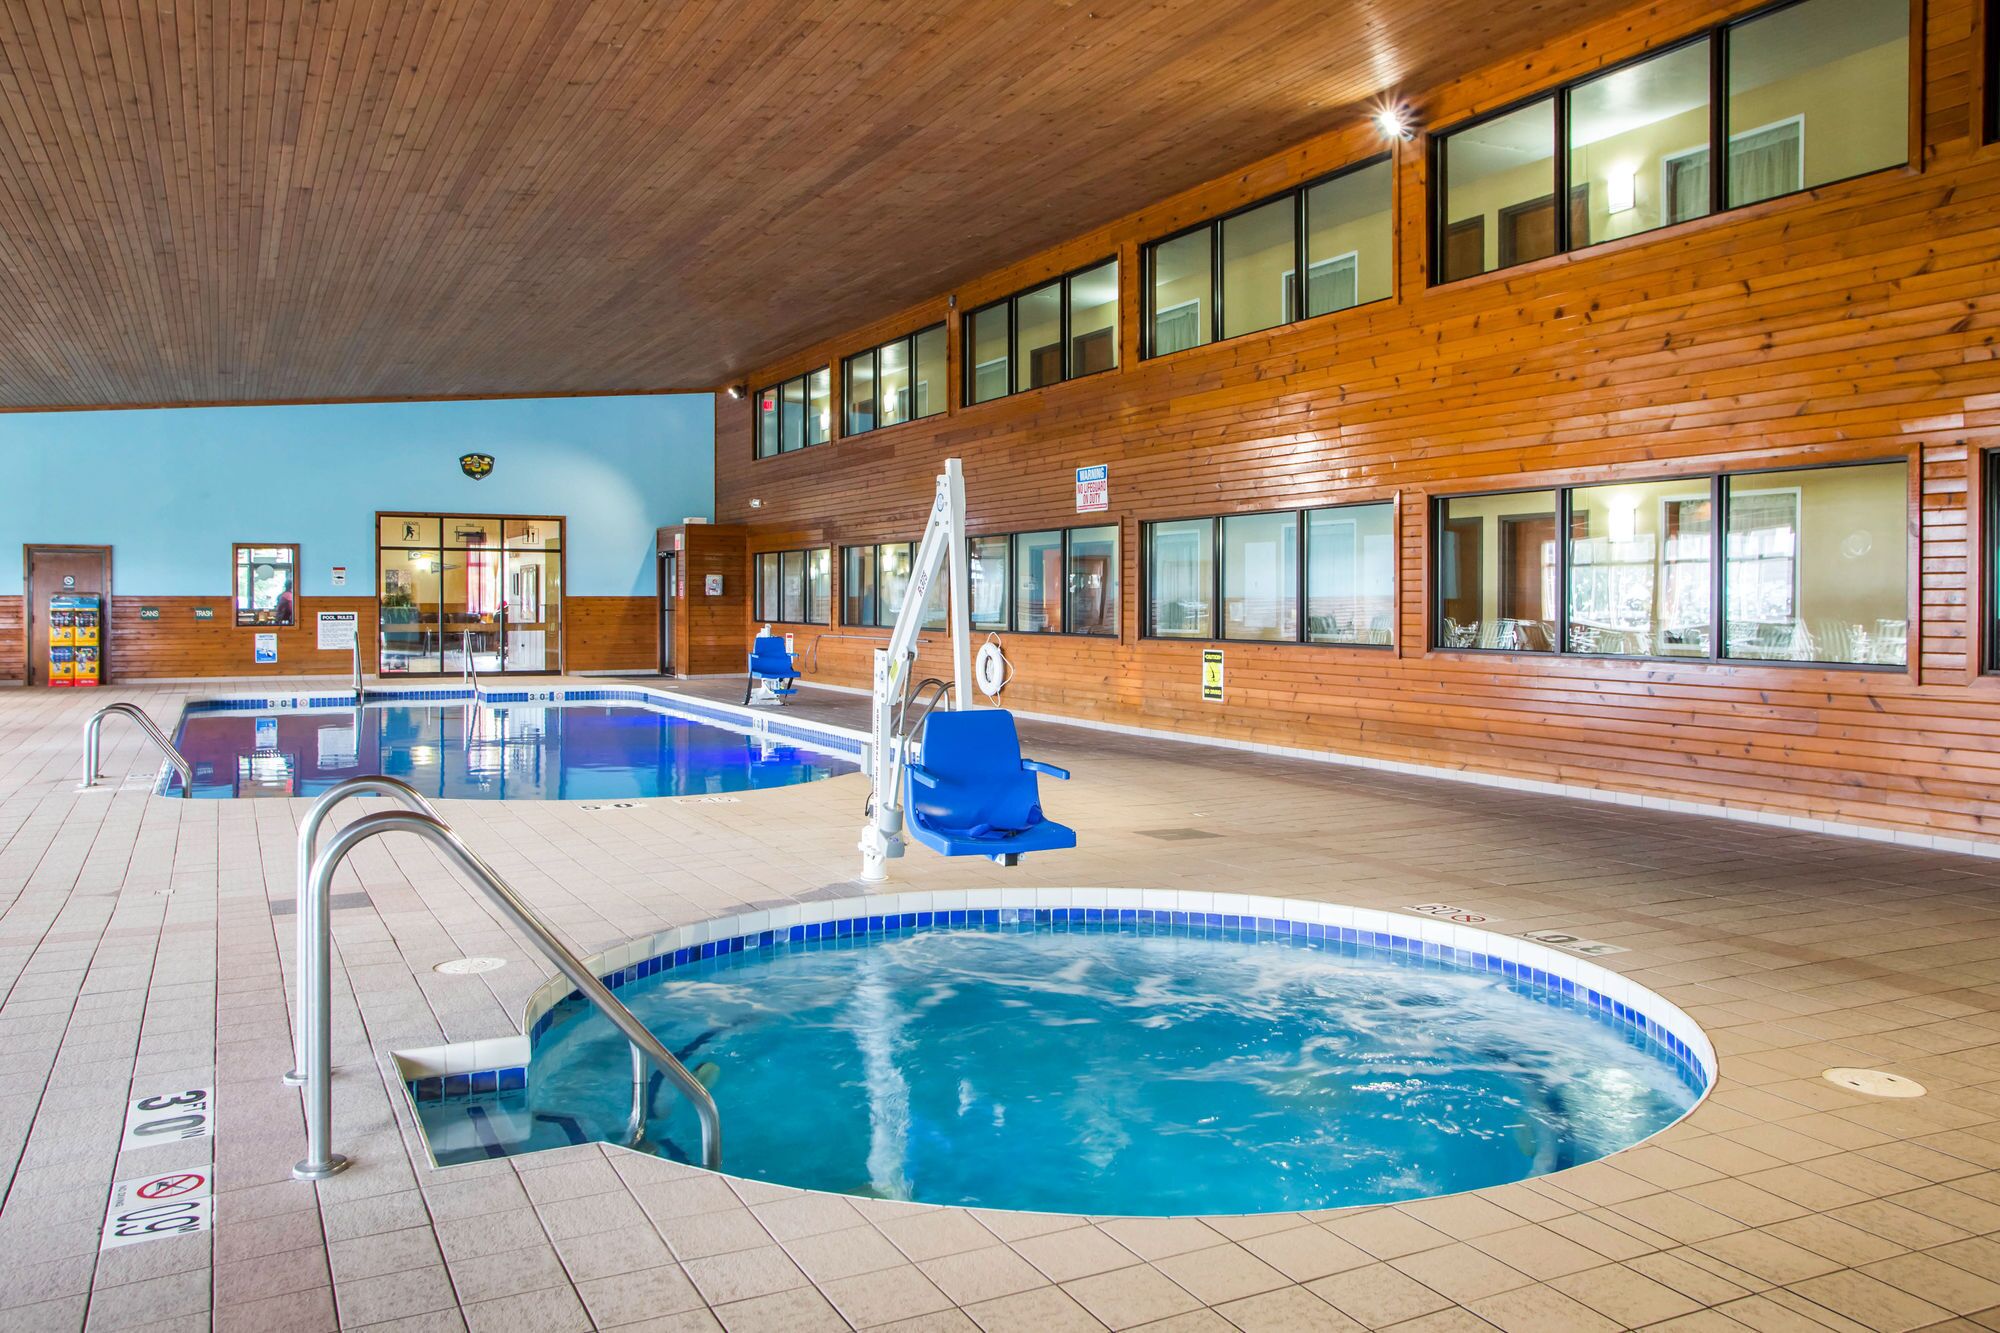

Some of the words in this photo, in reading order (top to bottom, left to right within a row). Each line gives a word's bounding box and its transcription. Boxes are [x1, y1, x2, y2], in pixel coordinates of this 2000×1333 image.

[1079, 466, 1105, 481] WARNING
[1078, 483, 1084, 493] NO
[1084, 480, 1106, 493] LIFEGUARD
[1083, 494, 1089, 504] ON
[1089, 493, 1101, 503] DUTY
[137, 1090, 206, 1111] 3
[133, 1114, 206, 1136] 0
